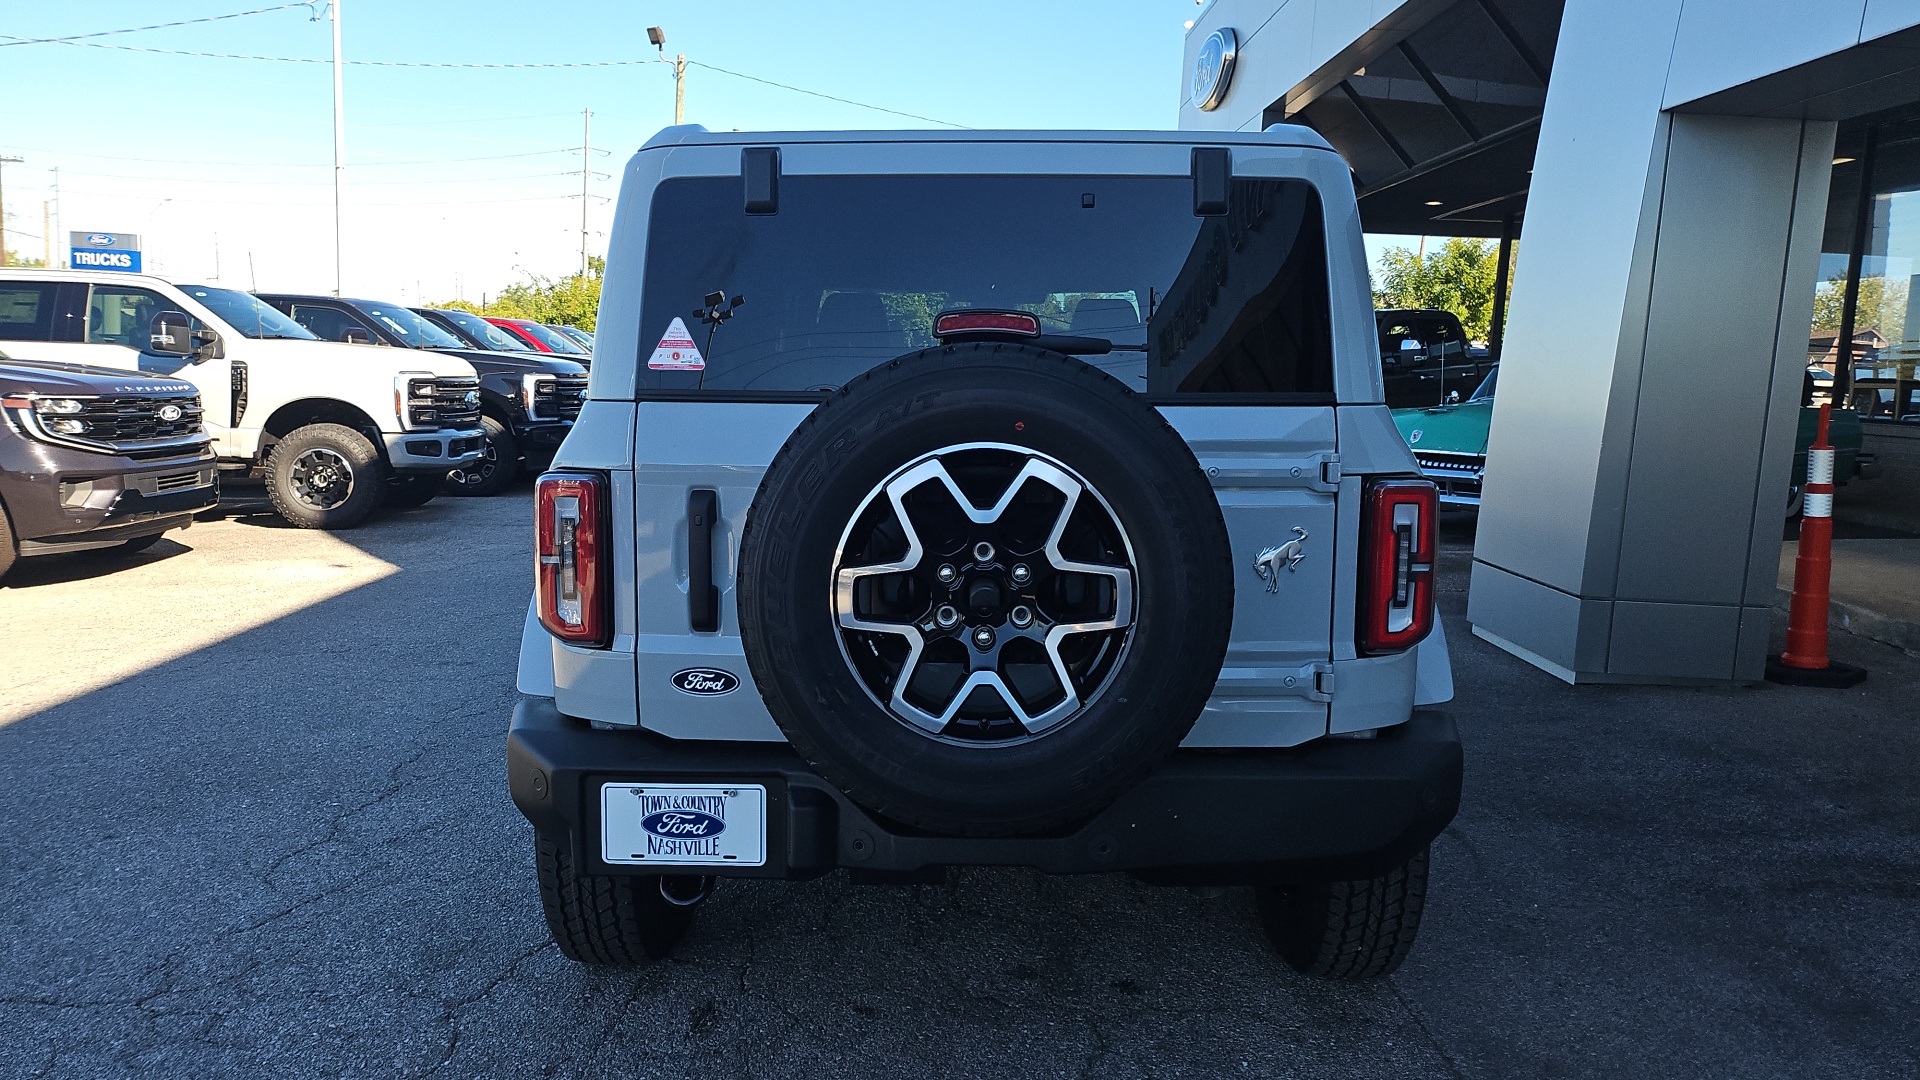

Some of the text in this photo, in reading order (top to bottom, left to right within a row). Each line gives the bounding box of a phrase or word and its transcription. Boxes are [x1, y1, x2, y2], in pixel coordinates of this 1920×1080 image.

[73, 252, 132, 268] TRUCKS
[684, 672, 725, 691] Ford
[638, 795, 728, 819] TOWN & COUNTRY
[657, 813, 709, 835] Ford
[646, 834, 720, 856] NASHVILLE
